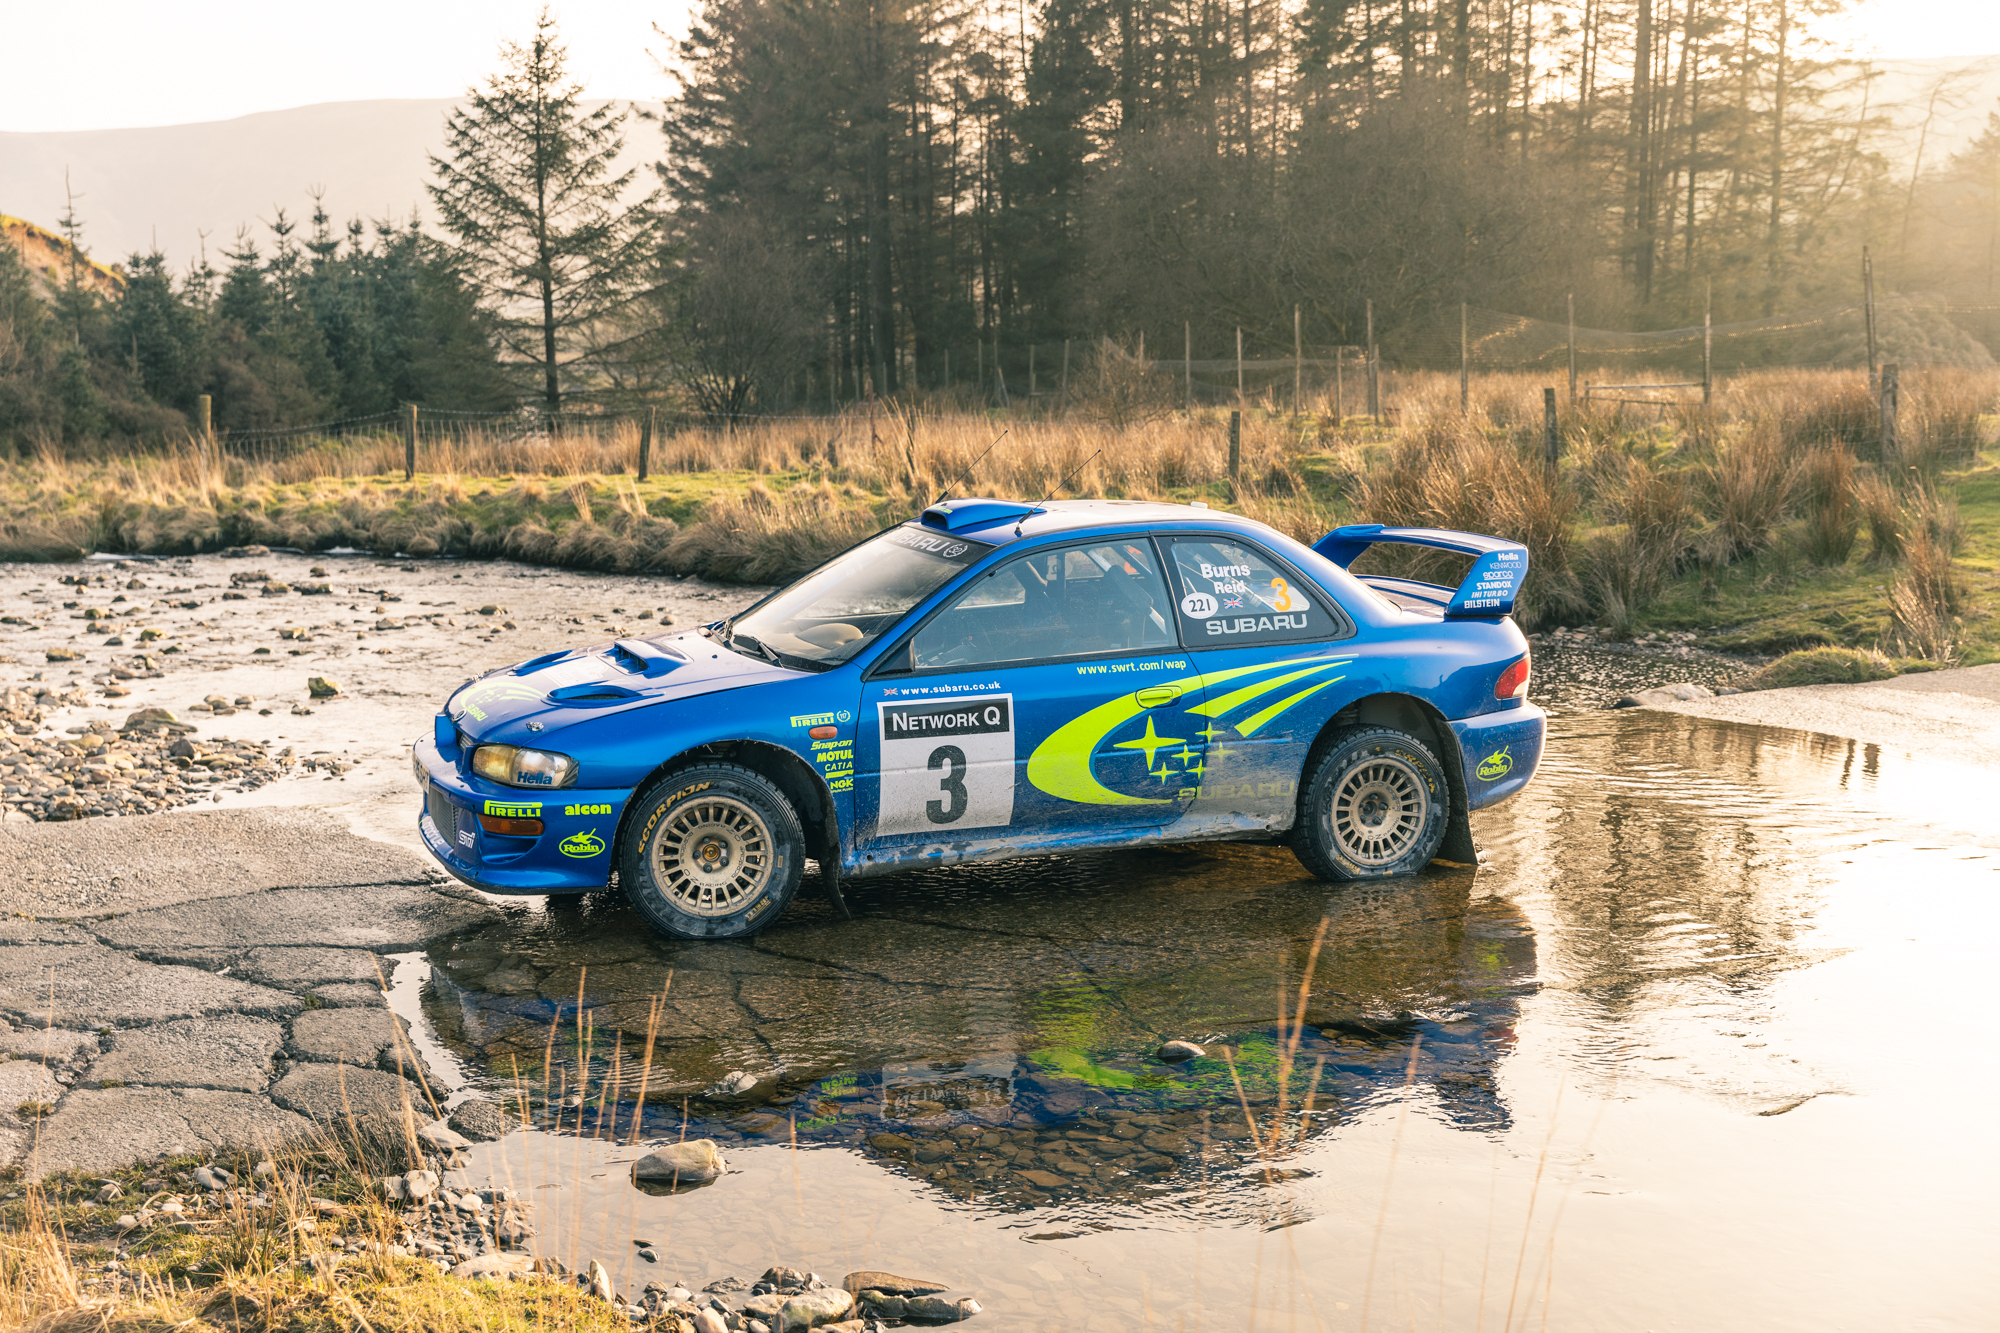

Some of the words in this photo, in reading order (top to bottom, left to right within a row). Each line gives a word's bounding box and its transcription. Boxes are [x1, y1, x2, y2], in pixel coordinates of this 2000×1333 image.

[1497, 552, 1519, 561] Hella
[1200, 563, 1251, 578] Burns
[1489, 561, 1522, 570] KENWOOD
[1482, 570, 1514, 580] sparco
[1213, 580, 1246, 594] Reid
[1476, 580, 1512, 590] STANDOX
[1270, 577, 1292, 612] 3
[1483, 589, 1509, 598] TURBO
[1188, 598, 1211, 613] 221
[1464, 598, 1500, 609] BILSTEIN
[1205, 613, 1307, 636] SUBARU
[1076, 659, 1187, 675] www.swrt.com/wap
[900, 680, 1001, 695] www.subaru.co.uk
[790, 712, 834, 727] PIRELLI
[983, 705, 1001, 726] Q
[810, 739, 853, 750] Snap-on
[816, 749, 854, 763] MOTUL
[824, 761, 853, 771] CATIA
[1479, 764, 1507, 776] Robin
[517, 771, 553, 785] Hella
[830, 778, 854, 789] NGK
[925, 744, 968, 825] 3
[1177, 781, 1295, 801] SUBARU
[484, 800, 543, 817] PIRELLI
[564, 803, 612, 816] alcon
[563, 843, 600, 854] Robin
